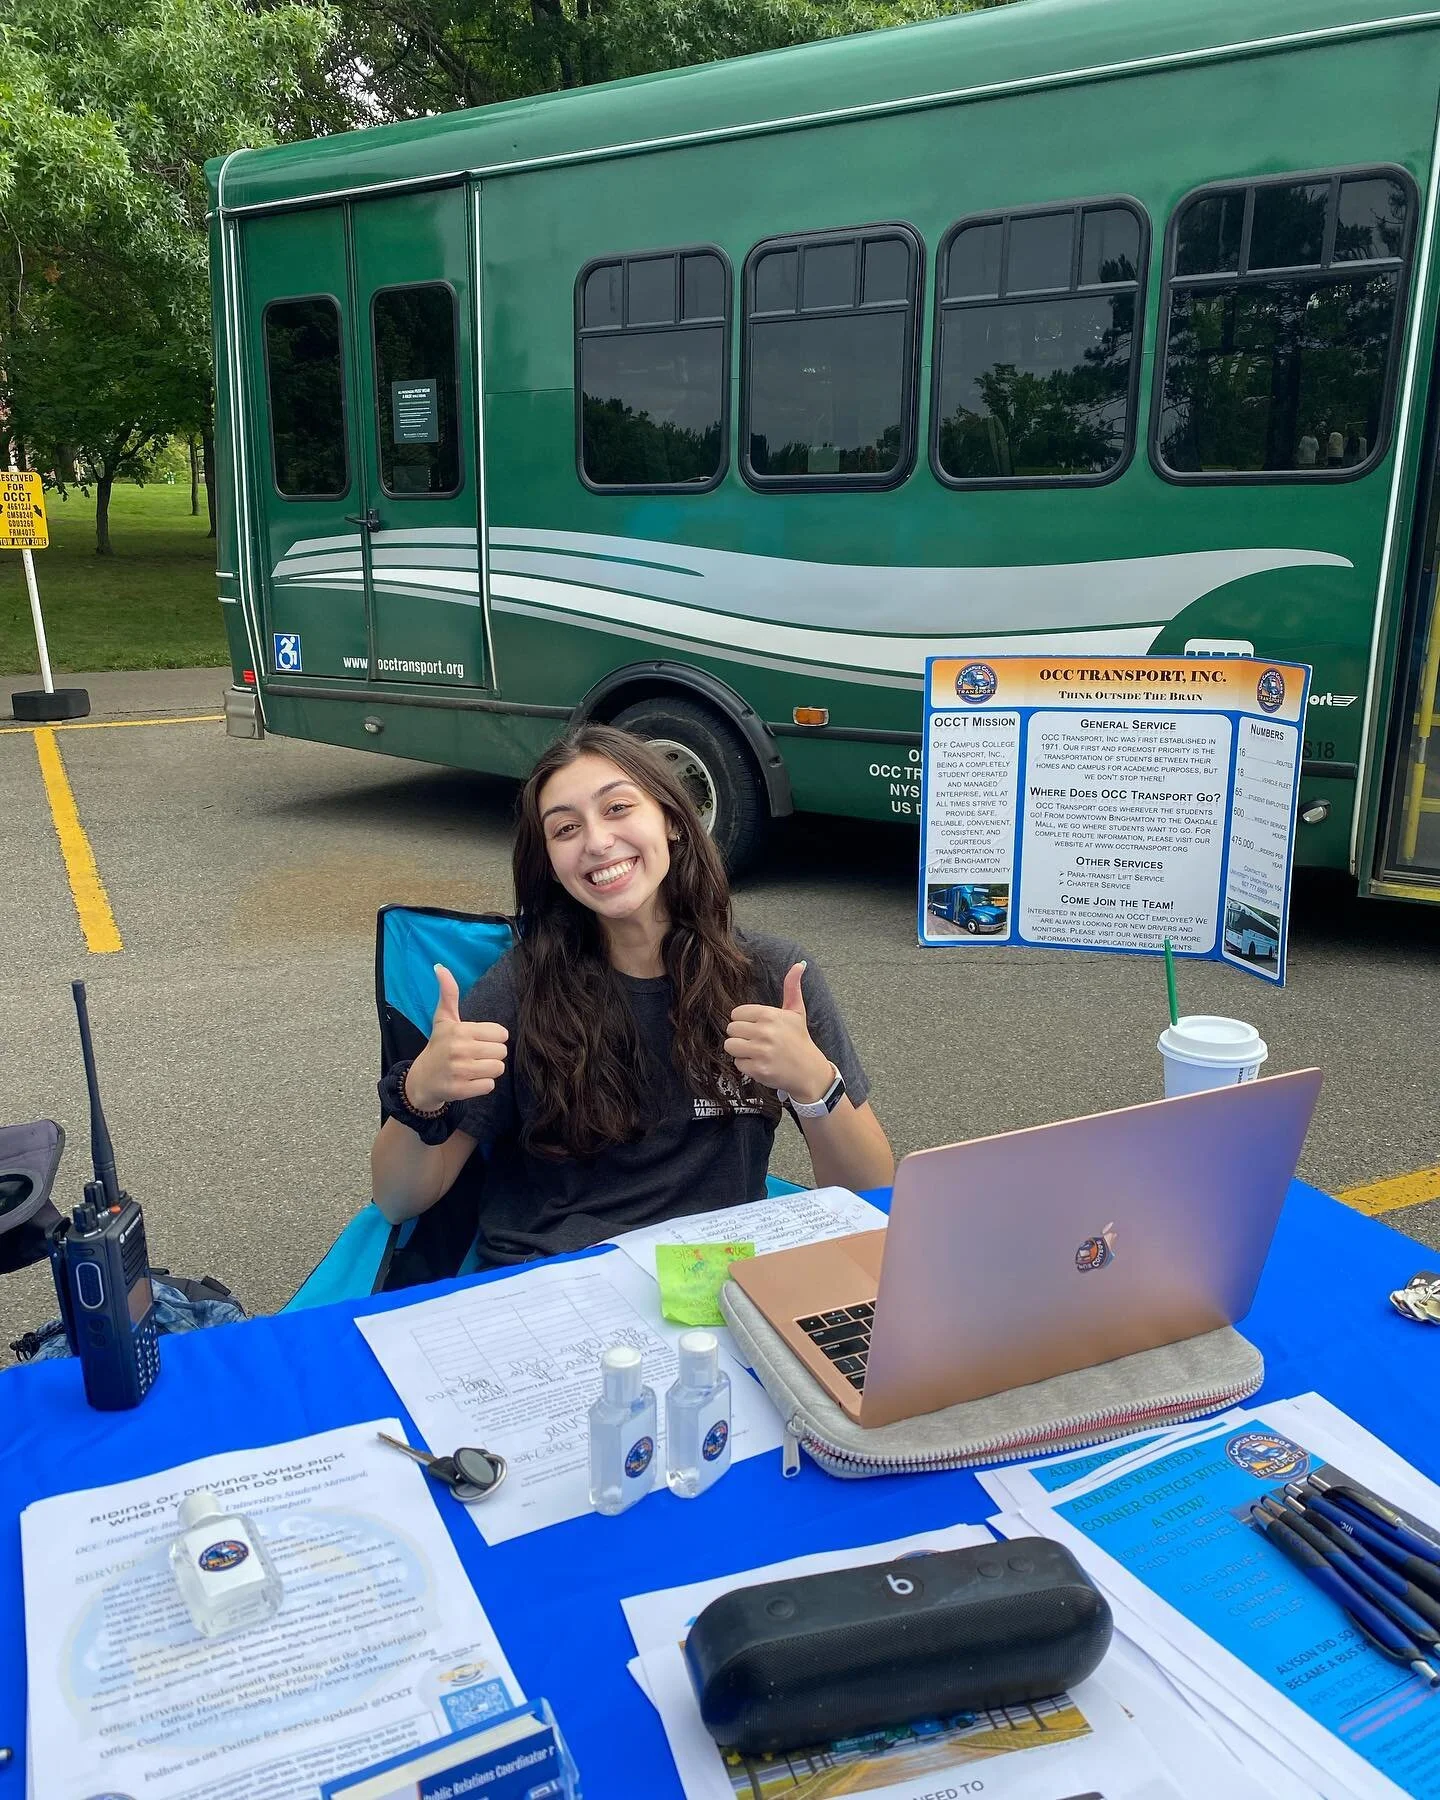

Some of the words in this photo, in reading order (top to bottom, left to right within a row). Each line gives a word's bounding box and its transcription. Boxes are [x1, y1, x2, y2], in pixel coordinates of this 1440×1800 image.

[4, 492, 32, 502] OCCT
[377, 658, 464, 678] occtransport.org
[1040, 668, 1074, 681] OCC
[1077, 669, 1186, 684] TRANSPORT,
[1190, 670, 1226, 682] INC.
[1058, 690, 1093, 700] THINK
[1095, 691, 1141, 700] OUTSIDE
[1144, 692, 1167, 700] THE
[1170, 692, 1203, 701] BRAIN
[934, 717, 968, 728] OCCT
[972, 717, 1016, 728] MISSION
[1080, 719, 1128, 730] GENERAL
[1132, 720, 1176, 730] SERVICE
[1041, 733, 1060, 741] OCC
[1062, 734, 1104, 742] TRANSPORT,
[1250, 723, 1284, 740] NUMBERS
[950, 740, 980, 748] CAMPUS
[982, 740, 1015, 748] COLLEGE
[943, 750, 986, 759] TRANSPORT,
[1239, 748, 1246, 757] 16
[869, 764, 902, 778] OCC
[1237, 768, 1244, 777] 18
[890, 783, 920, 798] NYS
[1030, 786, 1066, 797] WHERE
[1070, 788, 1098, 798] DOES
[1101, 790, 1128, 799] OCC
[1131, 790, 1193, 802] TRANSPORT
[1196, 792, 1220, 802] GO?
[892, 800, 912, 814] US
[1076, 856, 1110, 867] OTHER
[1114, 858, 1164, 870] SERVICES
[1067, 870, 1116, 880] PARA-TRANSIT
[1134, 874, 1164, 882] SERVICE
[1066, 880, 1099, 888] CHARTER
[1101, 882, 1131, 890] SERVICE
[1060, 894, 1090, 905] COME
[1093, 896, 1116, 906] JOIN
[1120, 900, 1138, 908] THE
[1142, 900, 1174, 910] TEAM!
[694, 1107, 730, 1116] VARSIT
[1253, 1450, 1305, 1477] TRANSPORT
[90, 1501, 150, 1524] RIDING
[262, 1462, 304, 1478] WHY
[307, 1452, 346, 1468] PICK
[1072, 1478, 1133, 1515] ALWAYS
[1132, 1454, 1194, 1490] WANTED
[1193, 1447, 1207, 1459] A
[109, 1506, 165, 1526] WHEN
[254, 1478, 280, 1490] DO
[282, 1464, 332, 1483] BOTH!
[1081, 1499, 1144, 1533] CORNER
[1142, 1474, 1197, 1505] OFFICE
[1194, 1458, 1235, 1482] WITH
[1151, 1516, 1165, 1530] A
[1164, 1494, 1208, 1522] VIEW?
[886, 1574, 914, 1595] b
[268, 1669, 288, 1682] Red
[292, 1660, 328, 1674] Mango
[361, 1628, 428, 1657] Marketplace)
[1276, 1647, 1318, 1676] ALYSON
[1286, 1662, 1330, 1690] BECAME
[1328, 1660, 1337, 1669] A
[1335, 1650, 1358, 1664] BUS
[144, 1762, 184, 1782] Follow
[220, 1734, 262, 1754] Twitter
[371, 1686, 414, 1708] @OCCT
[960, 1780, 984, 1794] TO
